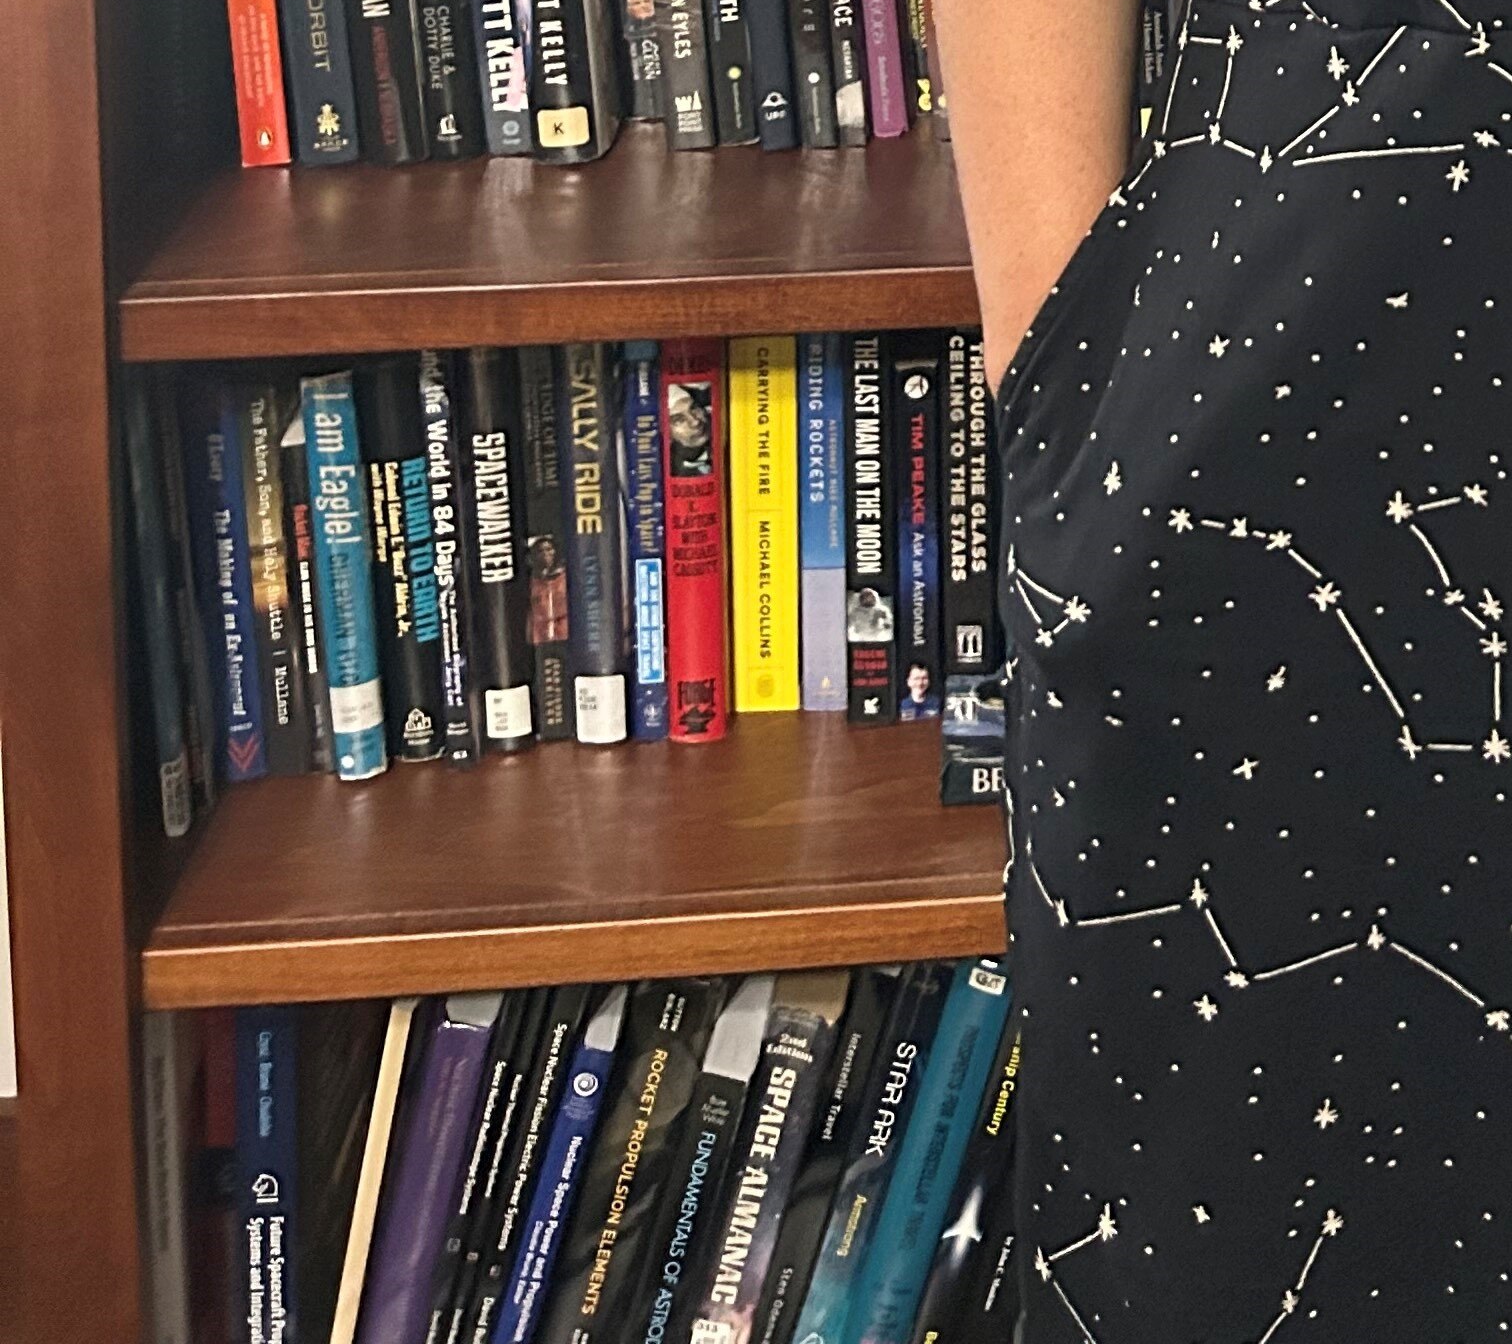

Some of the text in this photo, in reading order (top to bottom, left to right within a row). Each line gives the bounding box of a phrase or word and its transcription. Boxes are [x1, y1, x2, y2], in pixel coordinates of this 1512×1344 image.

[537, 19, 568, 87] KELLY
[670, 11, 691, 59] EYLES
[314, 411, 345, 452] am
[314, 464, 360, 545] Eagle!
[755, 348, 771, 658] CARRYING THE FIRE MICHAEL COLLINS
[853, 338, 880, 572] THE LAST MAN ON THE MOON
[910, 413, 924, 524] TIM PEAKE
[949, 335, 965, 581] CEILING TO THE STARS
[968, 341, 986, 571] THROUGH THE GLASS
[472, 433, 513, 582] SPACEWALKER
[865, 1041, 916, 1159] STAR ARK
[580, 1047, 667, 1316] ROCKET PROPULSION ELEMENTS
[710, 1064, 797, 1306] SPACE ALMANAC
